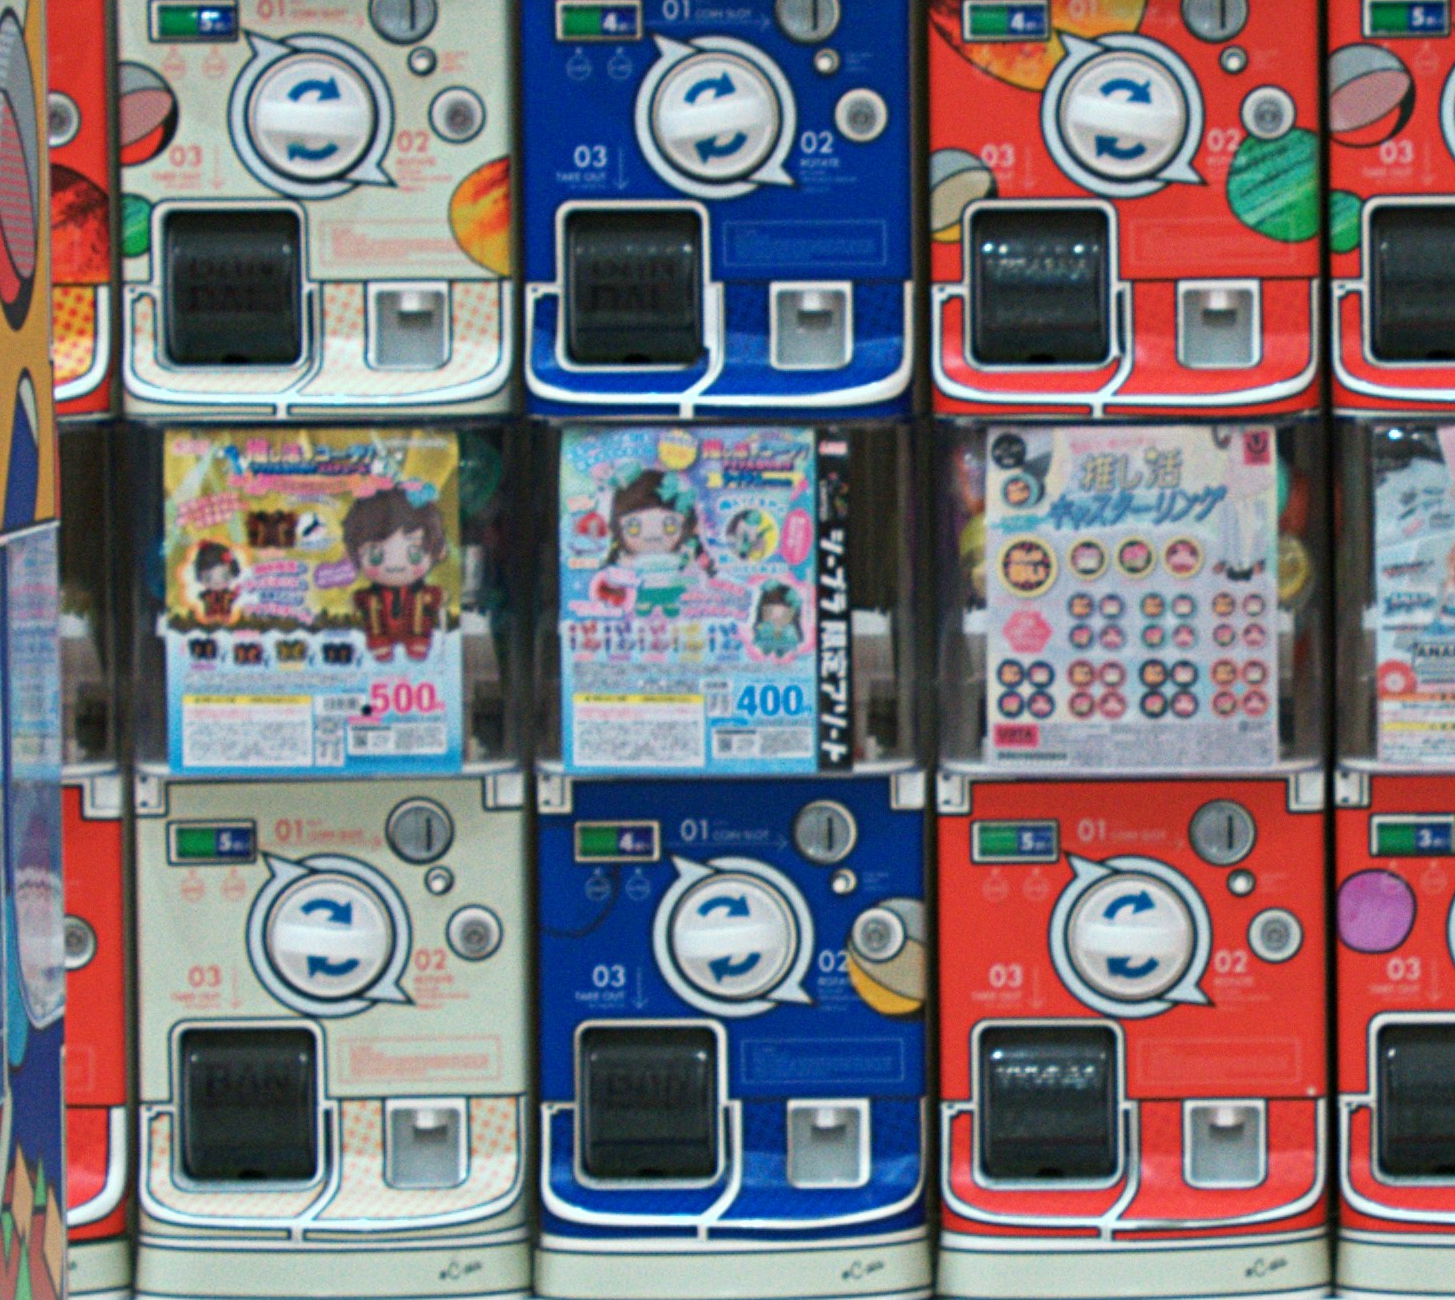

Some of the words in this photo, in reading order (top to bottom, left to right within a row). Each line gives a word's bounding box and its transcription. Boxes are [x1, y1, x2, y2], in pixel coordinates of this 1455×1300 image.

[801, 131, 833, 154] 02
[1207, 129, 1240, 151] 02
[574, 145, 607, 168] 03
[982, 143, 1015, 167] 03
[1380, 141, 1413, 165] 03
[275, 819, 303, 843] 01
[680, 819, 708, 842] 01
[1077, 819, 1106, 843] 01
[1214, 950, 1247, 973] 02
[1387, 957, 1420, 980] 03
[592, 965, 625, 987] 03
[989, 964, 1023, 988] 03
